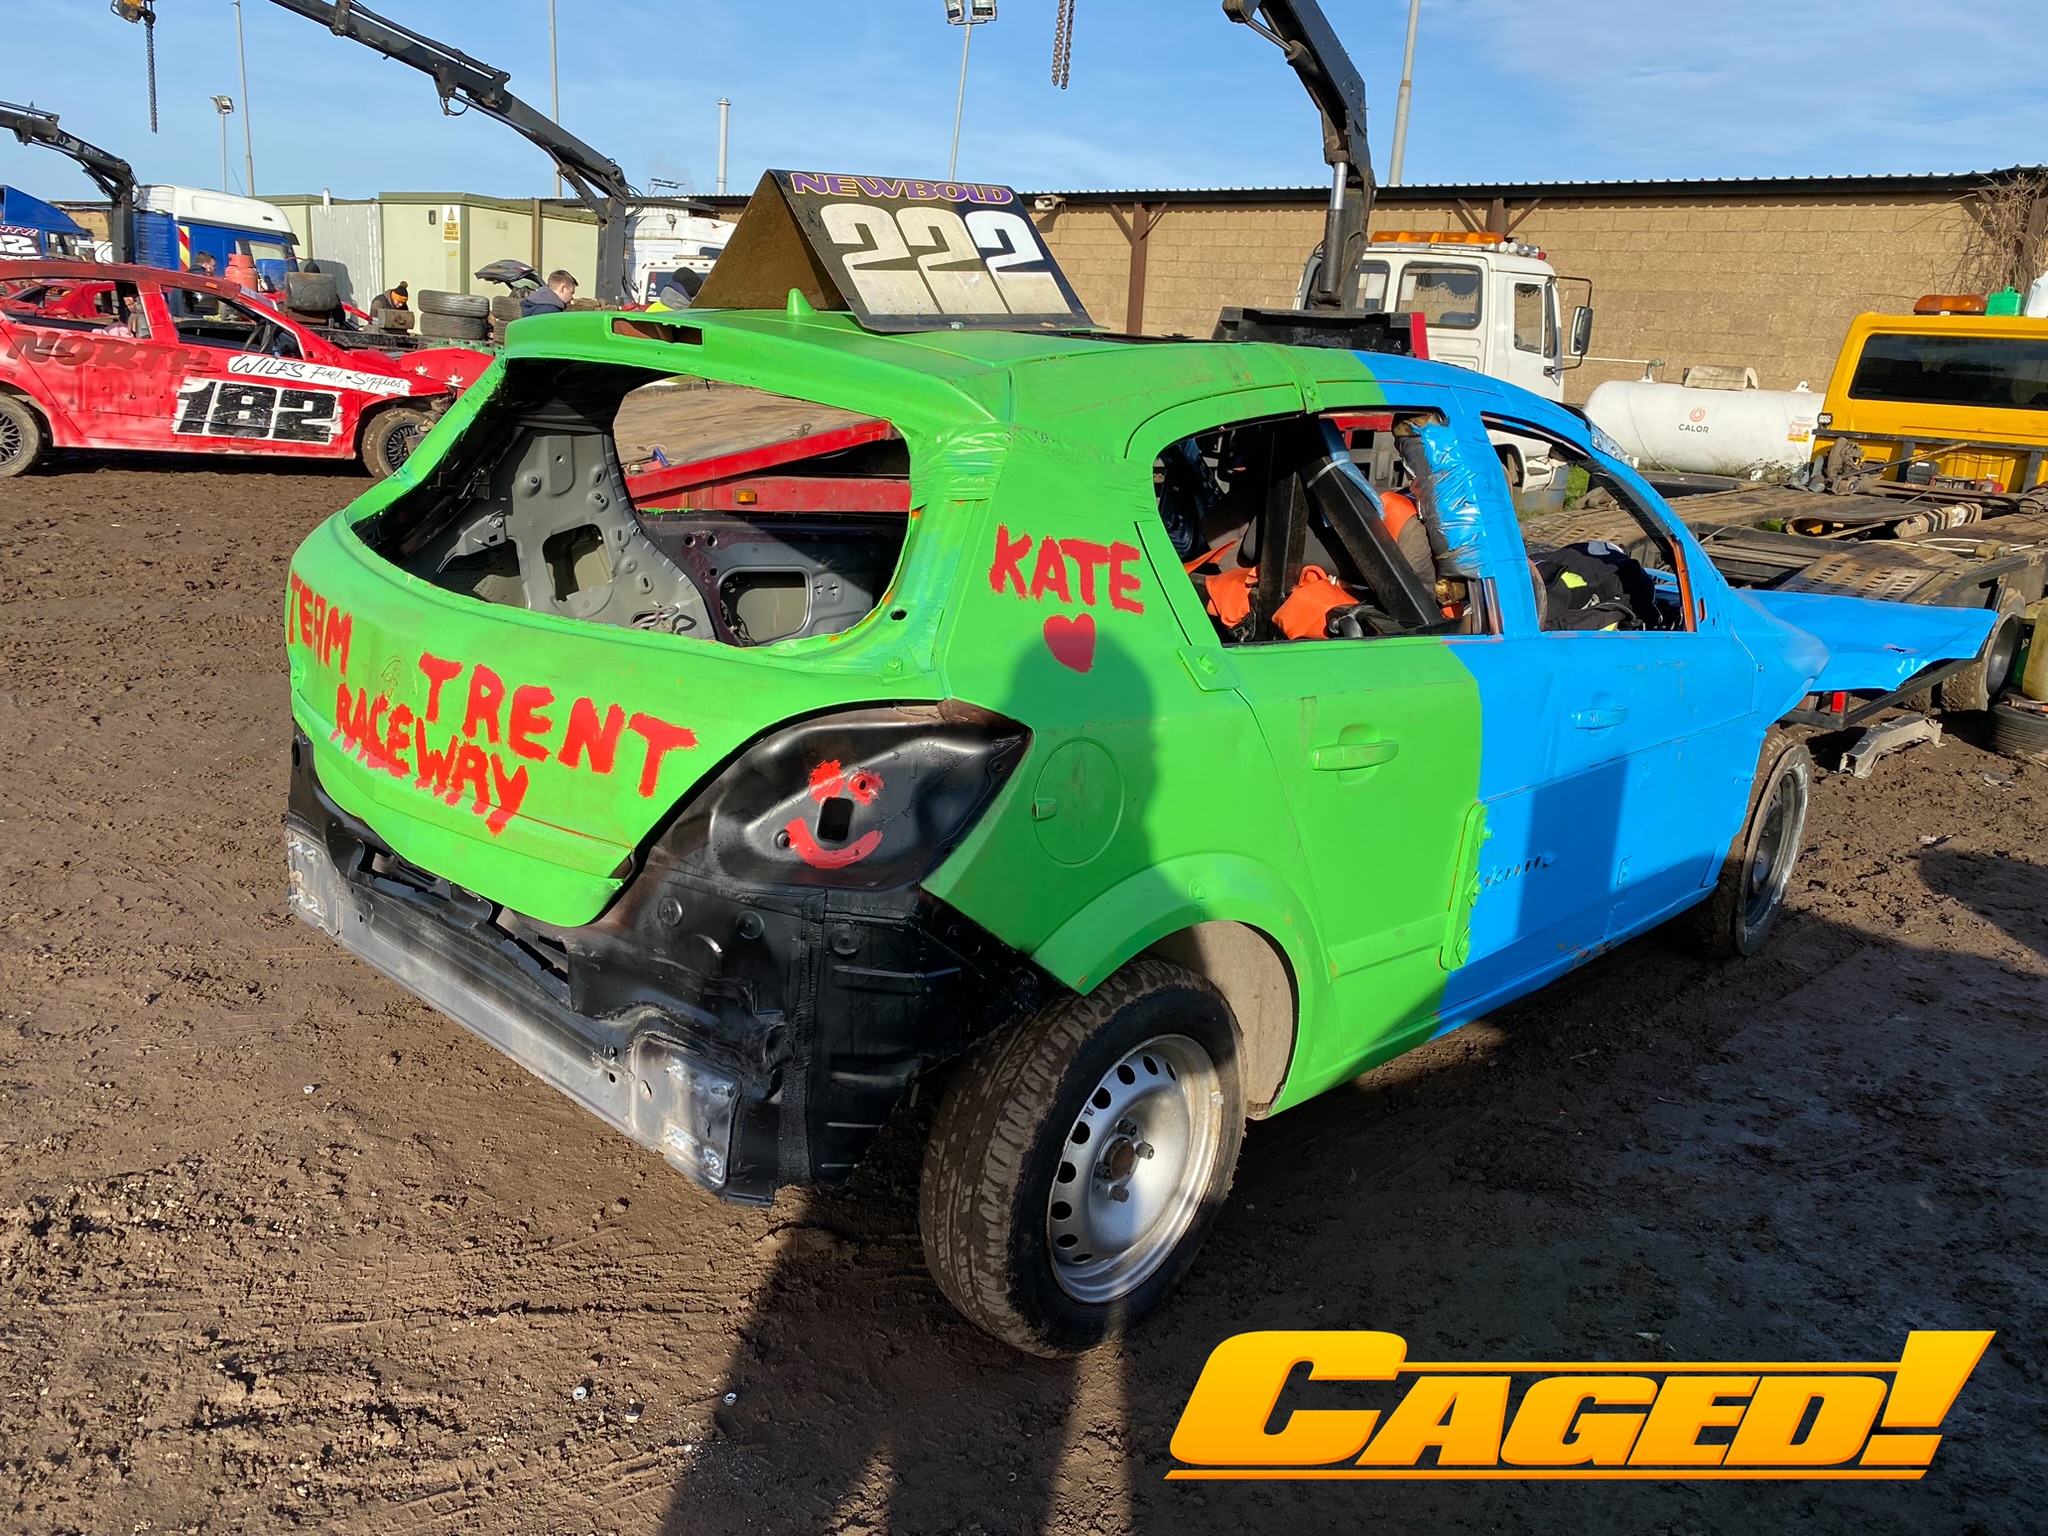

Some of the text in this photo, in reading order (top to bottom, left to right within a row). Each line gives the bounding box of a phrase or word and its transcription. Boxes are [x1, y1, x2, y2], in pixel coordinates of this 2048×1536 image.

[790, 172, 1014, 205] NEWBOLD
[820, 203, 1072, 315] 222
[175, 378, 338, 445] 182
[1678, 423, 1710, 434] CALOR
[989, 524, 1145, 615] KATE
[289, 569, 696, 798] TEAM TRENT
[330, 682, 529, 836] RACEWAY
